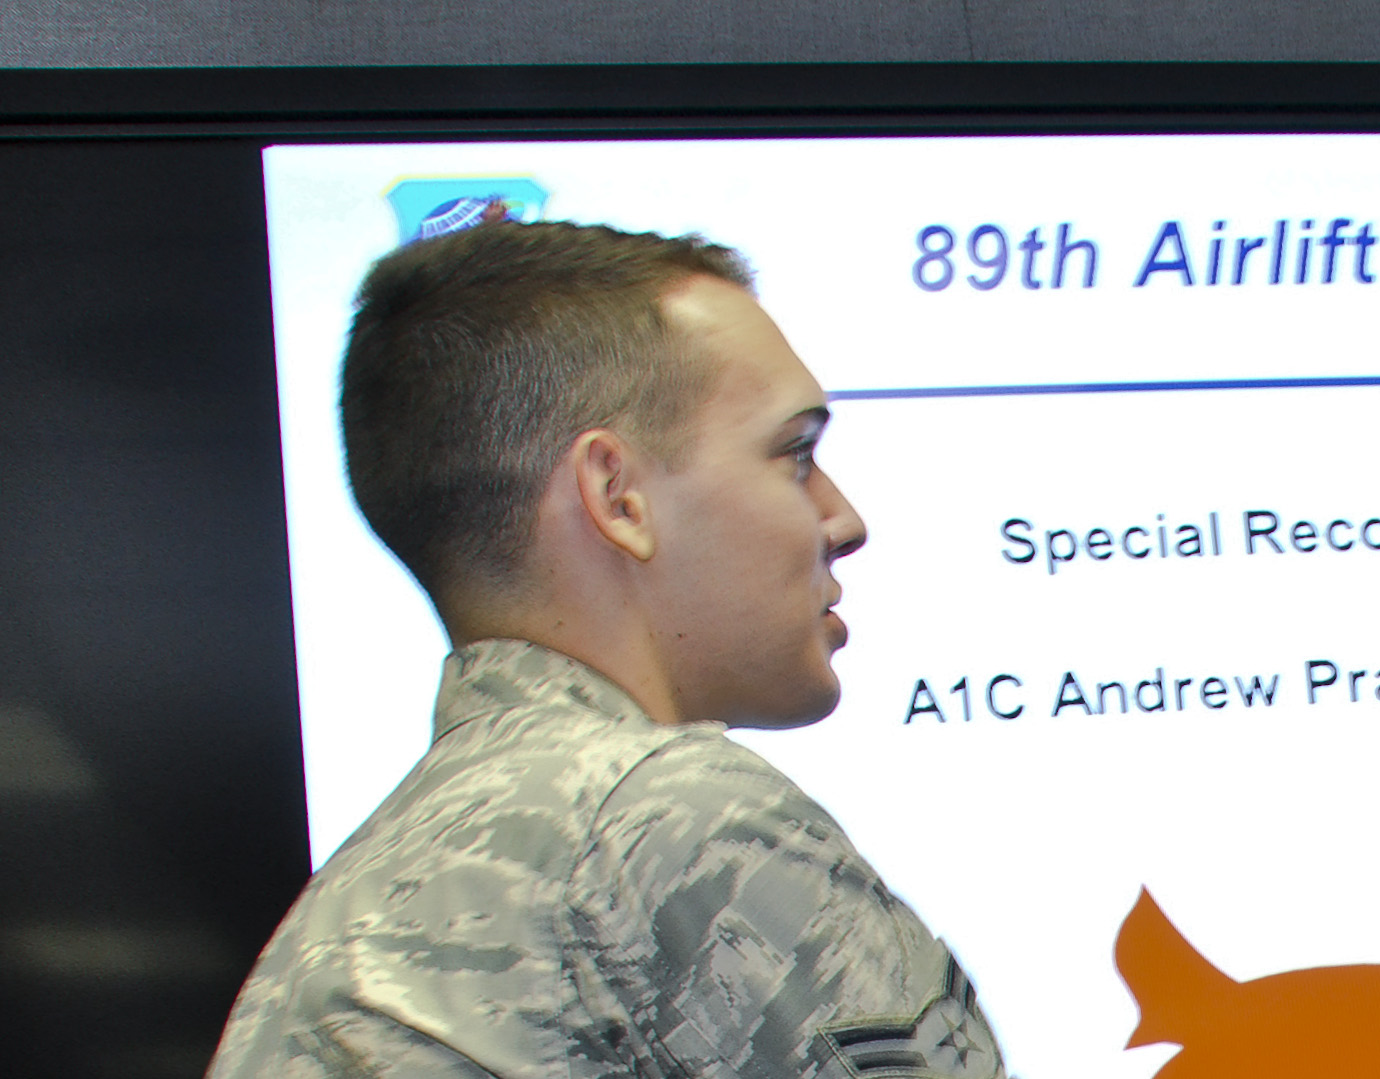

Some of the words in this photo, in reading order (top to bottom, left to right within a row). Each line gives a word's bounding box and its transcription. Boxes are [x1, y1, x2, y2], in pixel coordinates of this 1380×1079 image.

[911, 221, 1099, 292] 89th
[1132, 216, 1379, 288] Airlift
[1000, 511, 1220, 575] Special
[903, 673, 1025, 725] A1C
[1051, 667, 1279, 717] Andrew
